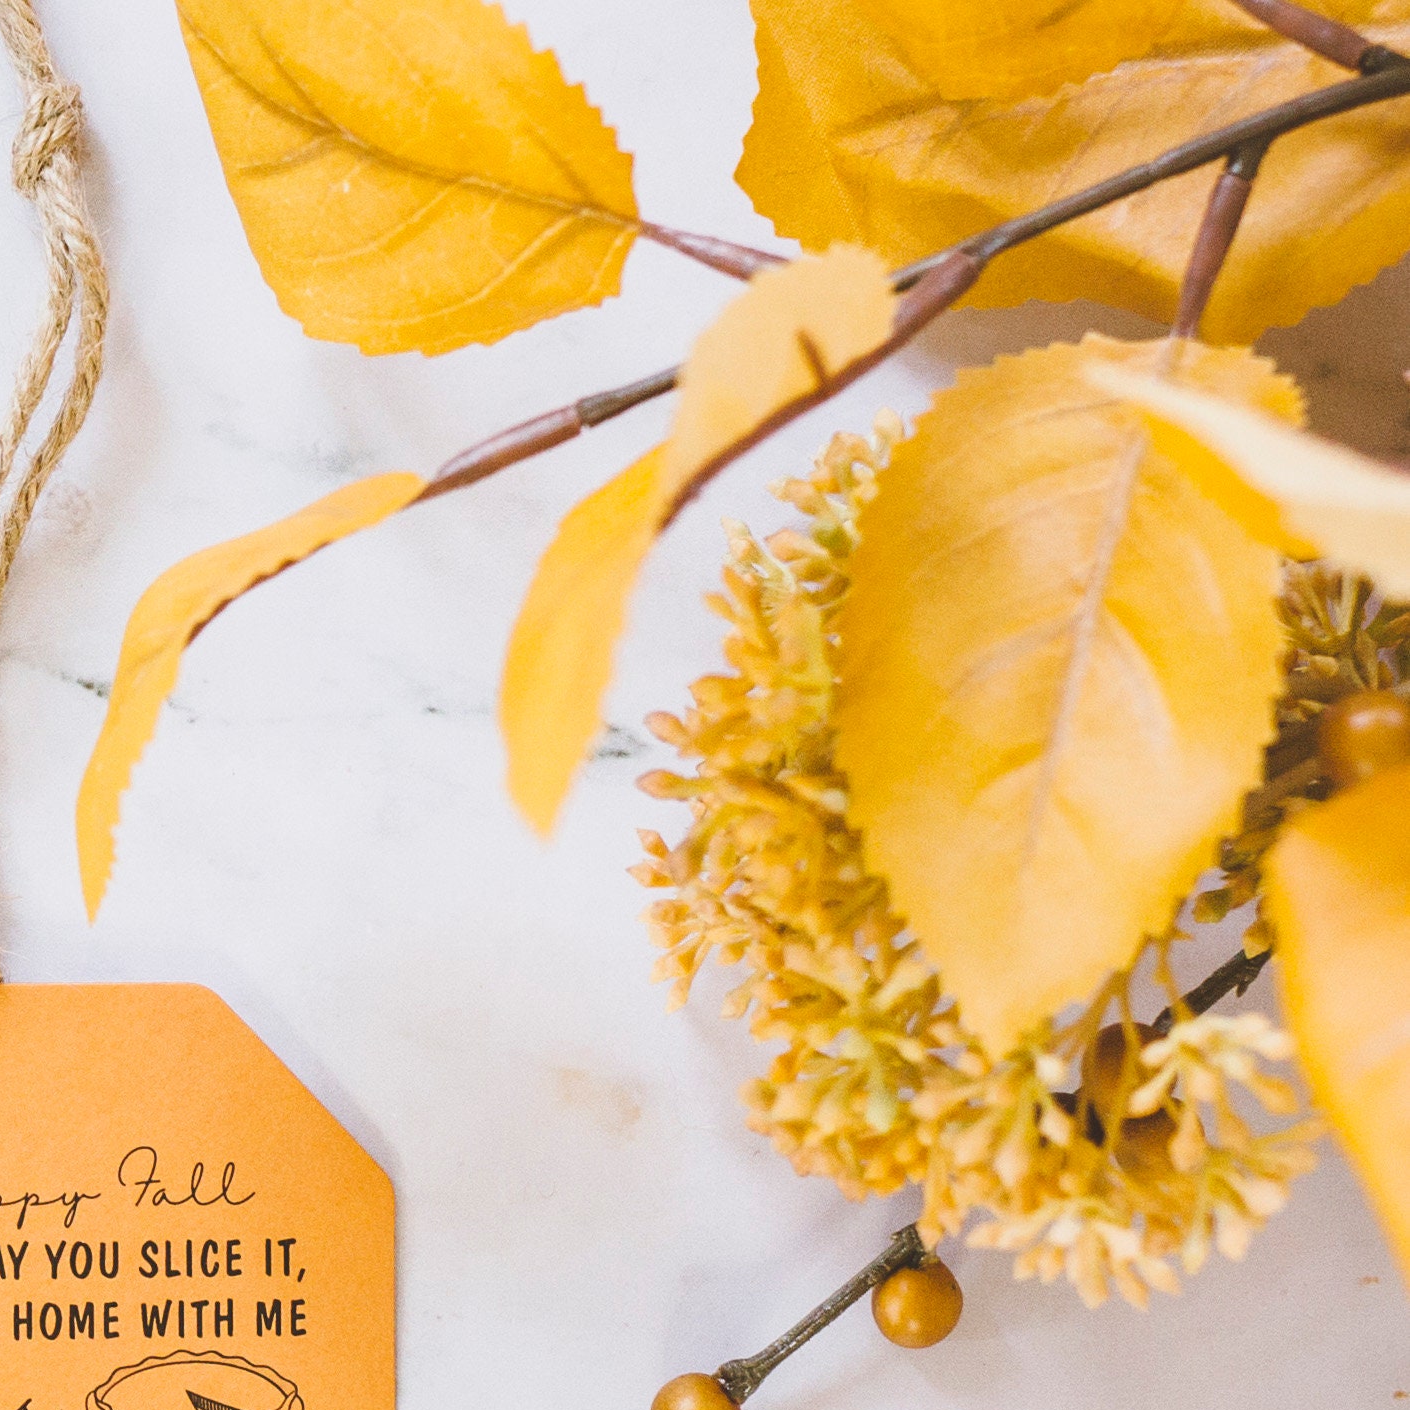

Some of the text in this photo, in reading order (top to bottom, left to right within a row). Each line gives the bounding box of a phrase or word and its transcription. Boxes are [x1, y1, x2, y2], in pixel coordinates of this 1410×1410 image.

[117, 1146, 256, 1207] Fall
[44, 1240, 119, 1280] YOU
[138, 1239, 243, 1279] SLICE
[264, 1237, 306, 1283] IT,
[13, 1301, 120, 1341] HOME
[140, 1298, 234, 1339] WITH
[256, 1298, 307, 1338] ME
